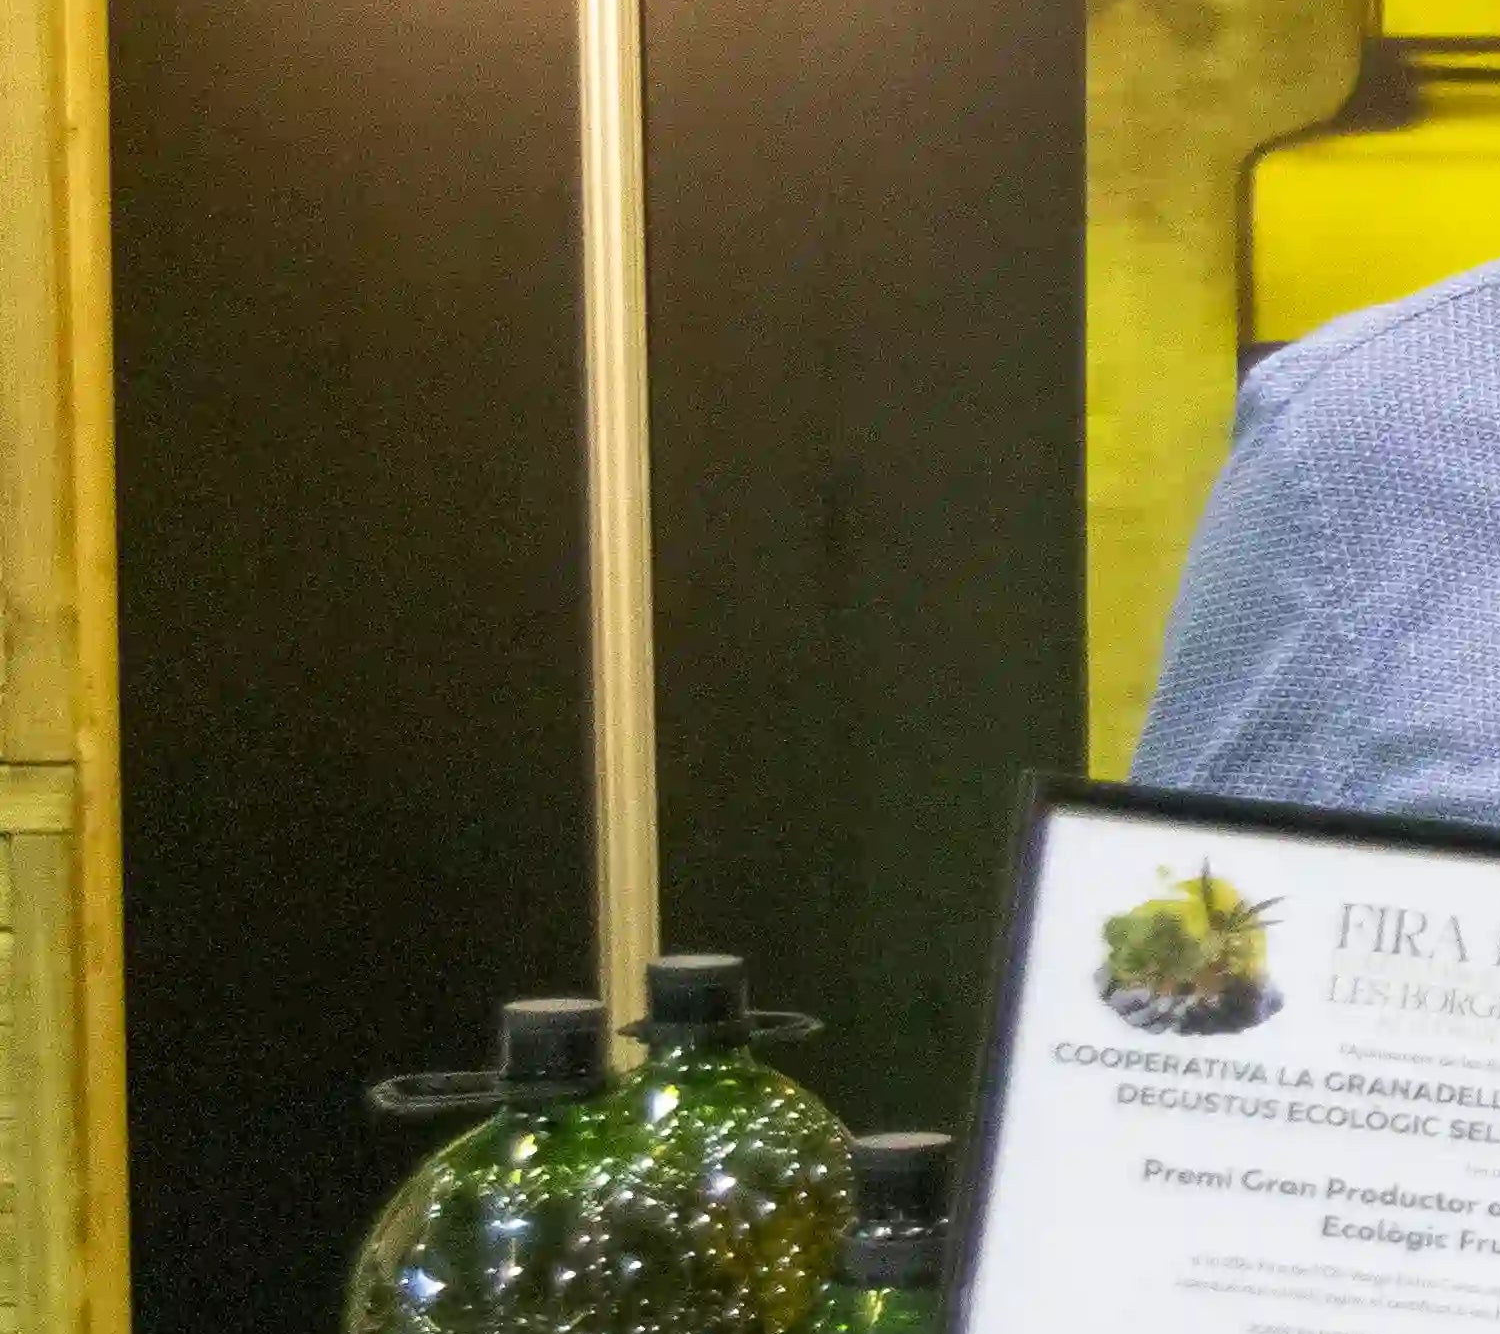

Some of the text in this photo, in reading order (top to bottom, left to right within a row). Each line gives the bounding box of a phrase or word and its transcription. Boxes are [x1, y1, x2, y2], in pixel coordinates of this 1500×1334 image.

[1335, 901, 1469, 964] FIRA
[1324, 974, 1392, 1010] LES
[1053, 1041, 1268, 1084] COOPERATIVA
[1276, 1066, 1314, 1089] LA
[1115, 1082, 1279, 1120] DEGUSTUS
[1284, 1100, 1439, 1138] ECOLÒGIC
[1141, 1157, 1233, 1189] Premi
[1239, 1168, 1317, 1198] Gran
[1323, 1176, 1478, 1214] Productor
[1319, 1213, 1447, 1252] Ecològic
